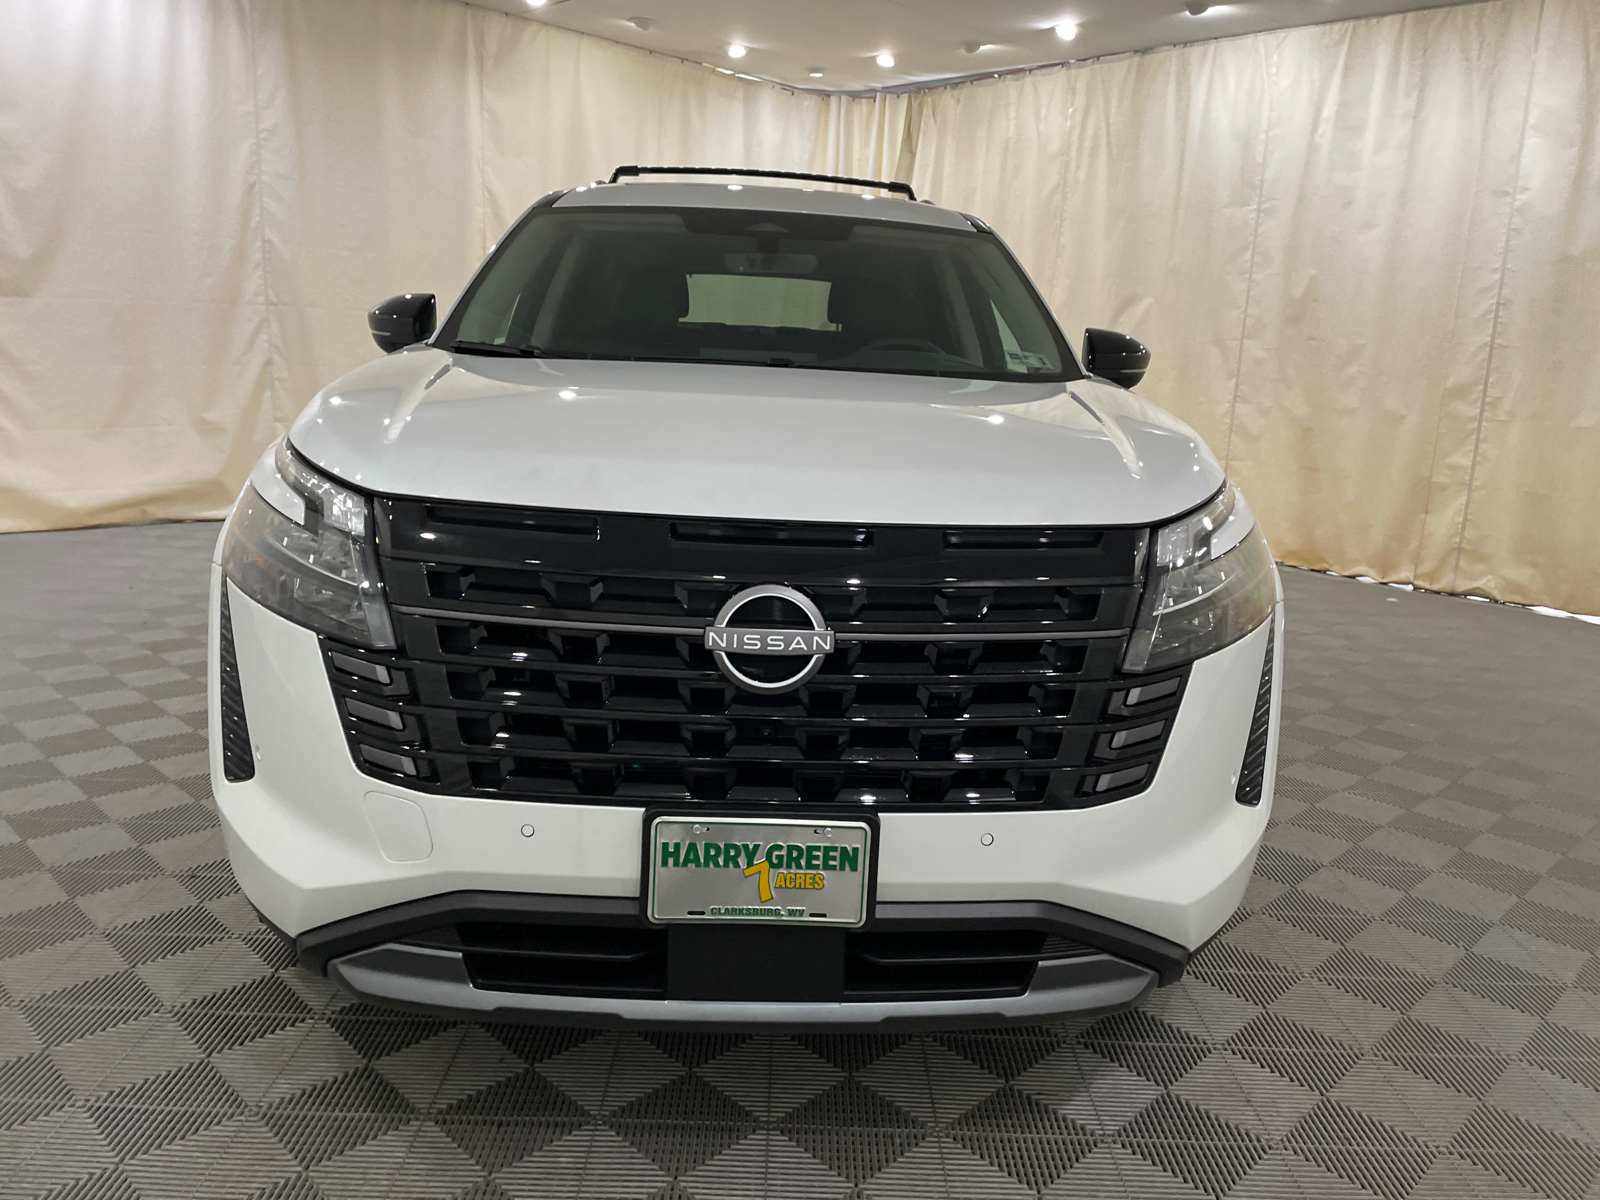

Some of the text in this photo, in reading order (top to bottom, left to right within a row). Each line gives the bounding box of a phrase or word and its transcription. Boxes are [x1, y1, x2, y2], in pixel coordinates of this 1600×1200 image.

[708, 631, 831, 651] NISSAN
[661, 841, 860, 872] HARRY GREEN
[743, 860, 825, 903] 7 ACRES
[710, 906, 806, 918] CLARKSBURG, WV
